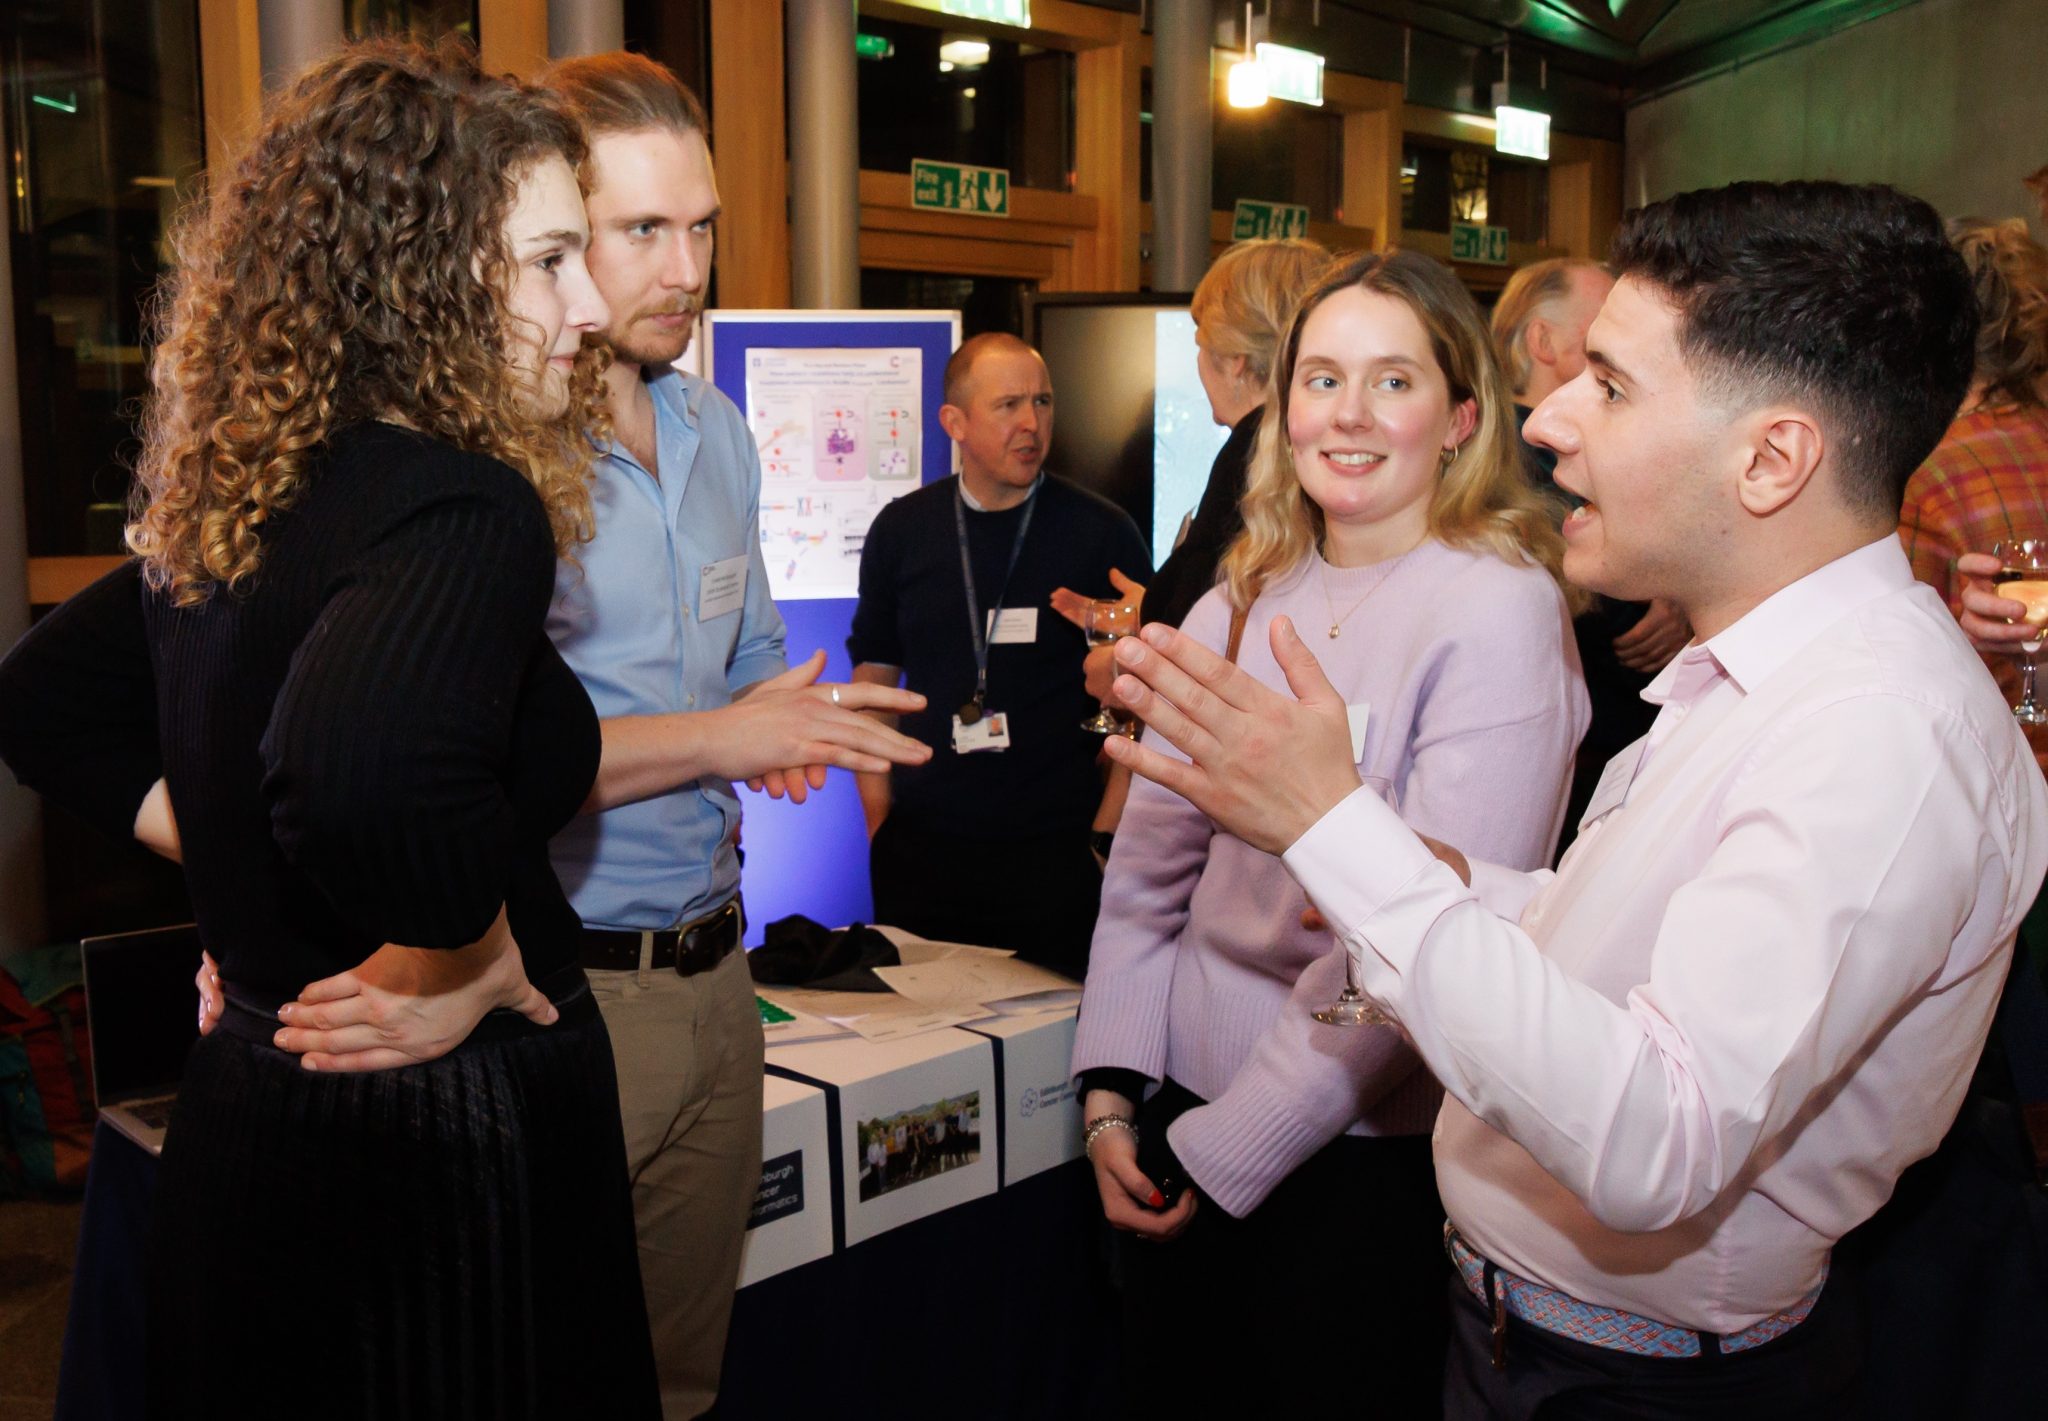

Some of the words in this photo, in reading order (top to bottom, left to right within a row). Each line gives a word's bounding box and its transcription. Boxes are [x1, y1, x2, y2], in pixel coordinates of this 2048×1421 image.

[917, 168, 939, 185] Fire
[917, 187, 938, 202] exit
[759, 1164, 794, 1185] nburgh
